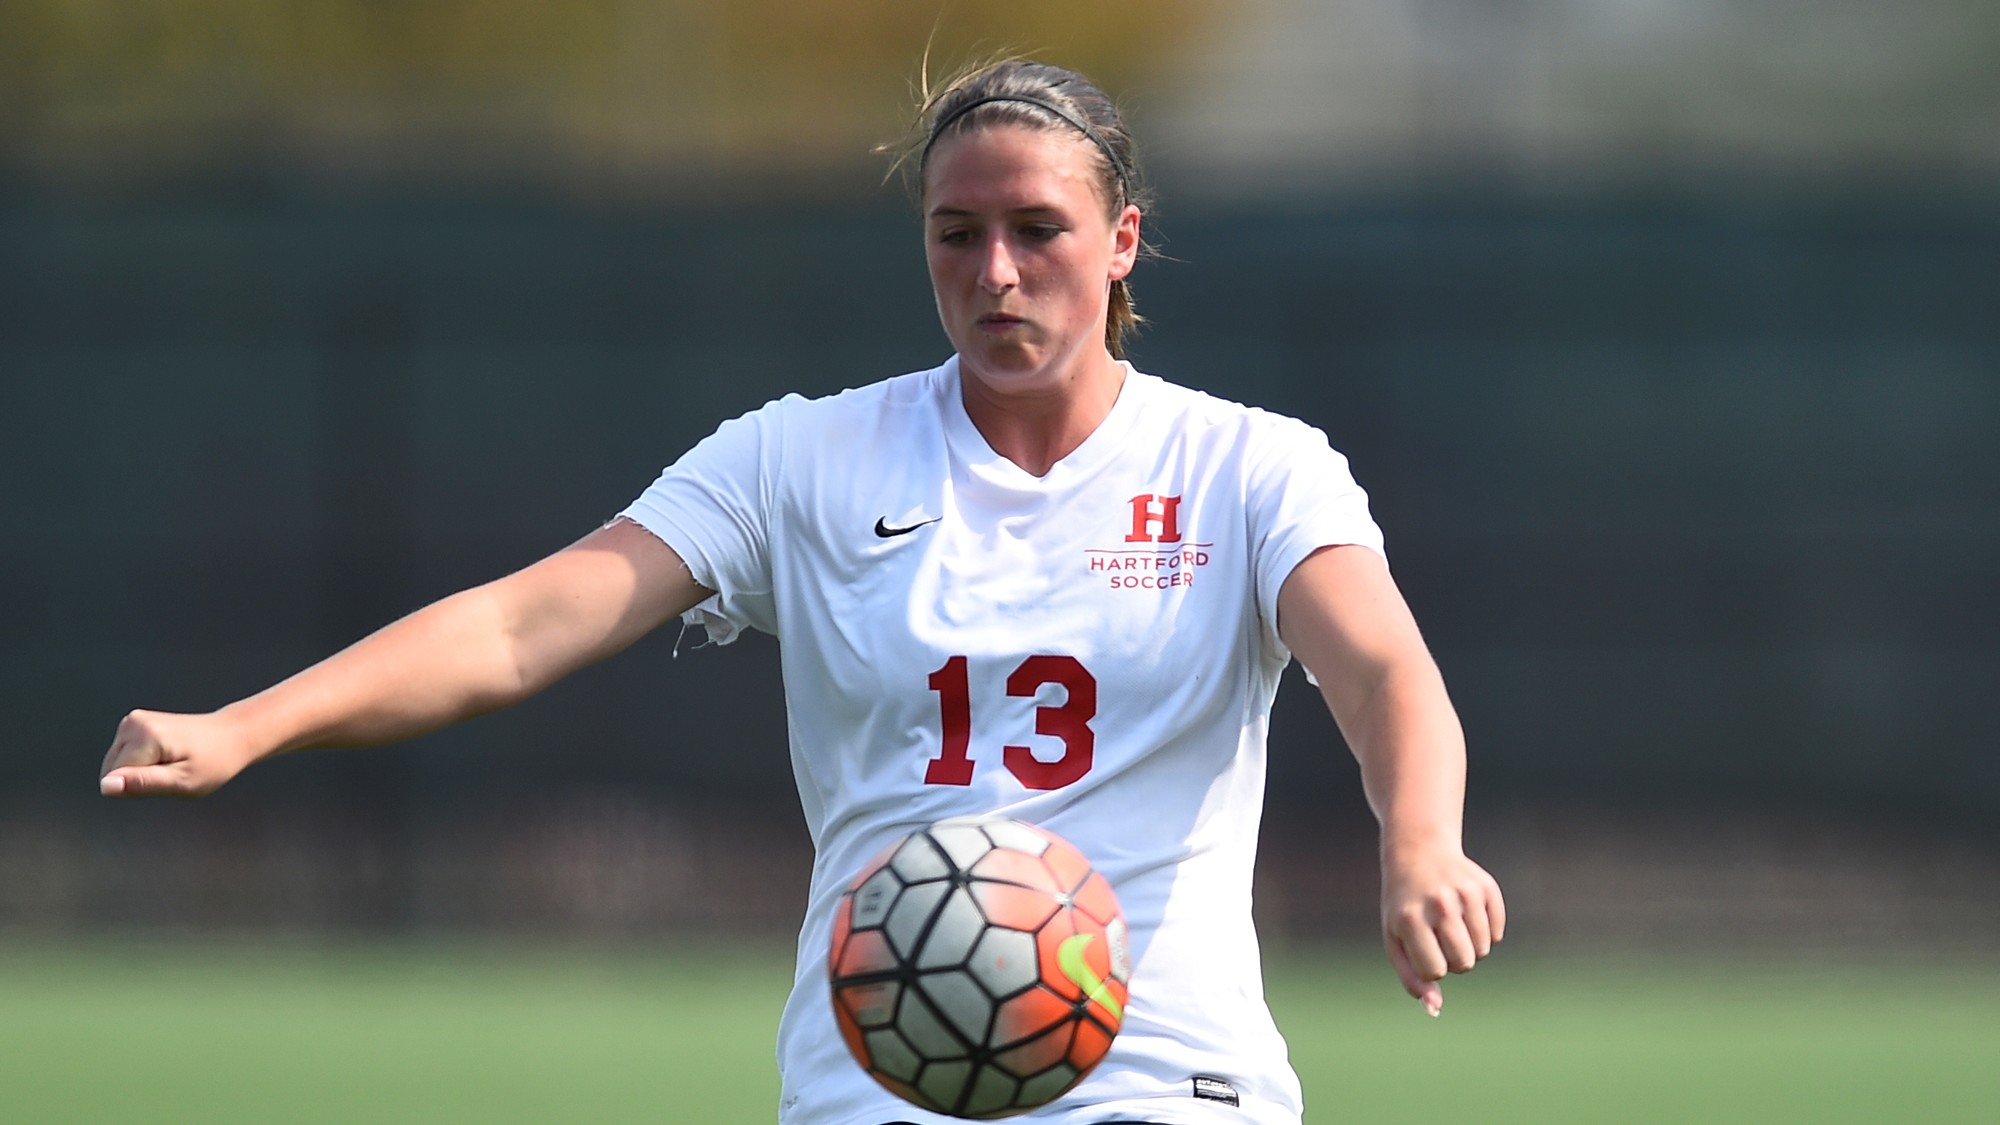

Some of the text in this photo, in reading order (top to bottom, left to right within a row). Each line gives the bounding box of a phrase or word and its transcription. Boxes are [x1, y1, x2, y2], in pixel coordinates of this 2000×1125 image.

[1125, 494, 1181, 543] H
[1090, 551, 1209, 571] HARTFORD
[1110, 572, 1193, 589] SOCCER
[924, 655, 1097, 790] 13
